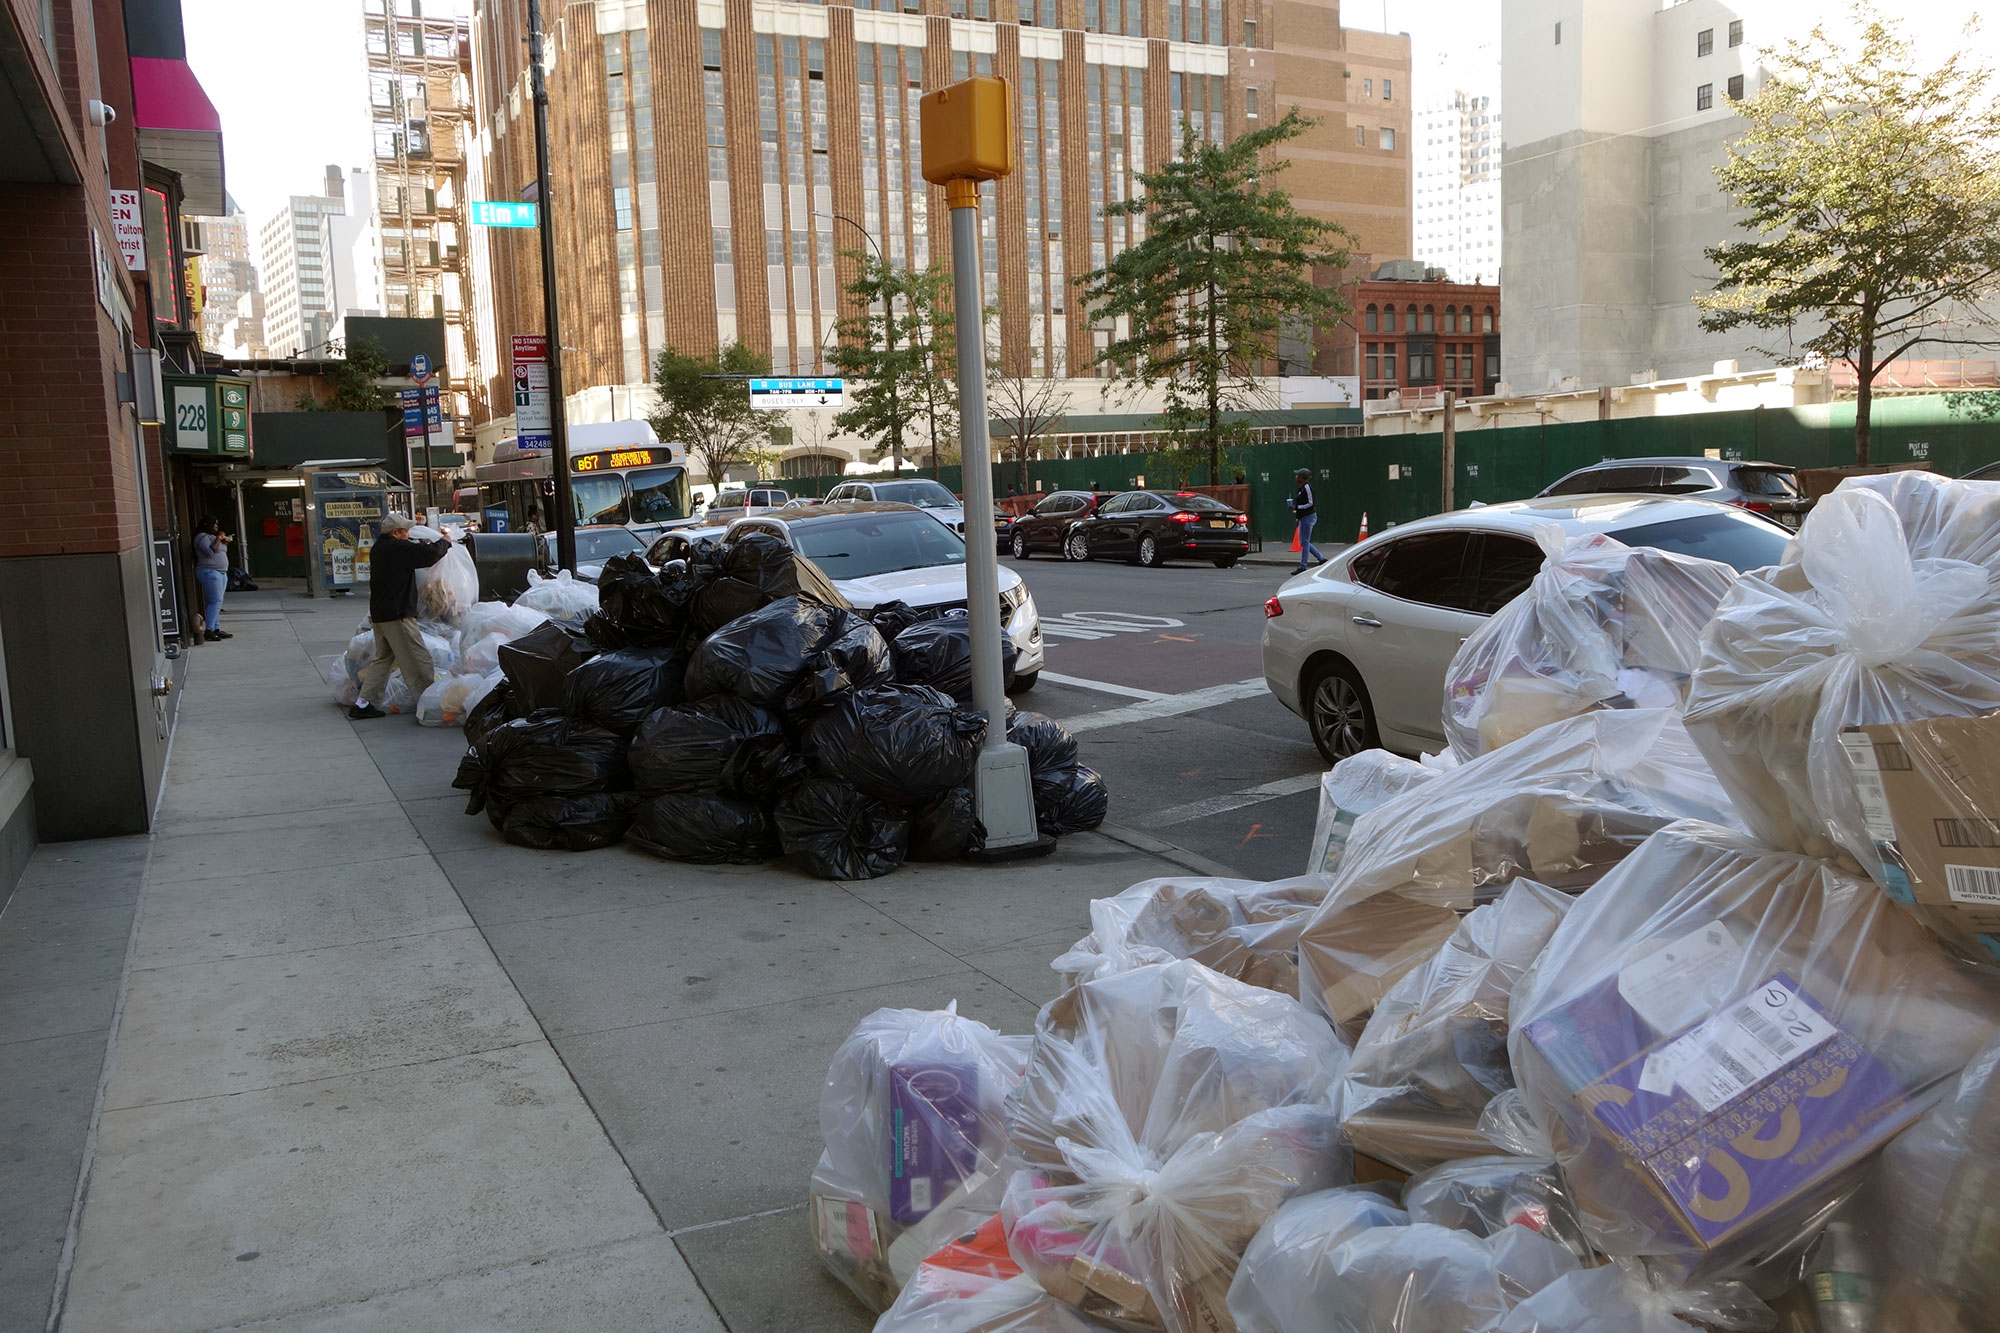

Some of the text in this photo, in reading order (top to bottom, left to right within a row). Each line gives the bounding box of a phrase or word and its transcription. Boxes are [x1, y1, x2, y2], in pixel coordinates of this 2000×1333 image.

[120, 194, 136, 205] St
[112, 209, 131, 220] EN
[480, 203, 512, 224] Elm
[118, 224, 143, 234] Fulton
[118, 239, 140, 250] trist
[177, 403, 206, 432] 228
[524, 441, 552, 449] 342488
[577, 450, 649, 471] B67 KENSINGTON
[334, 555, 353, 564] Model
